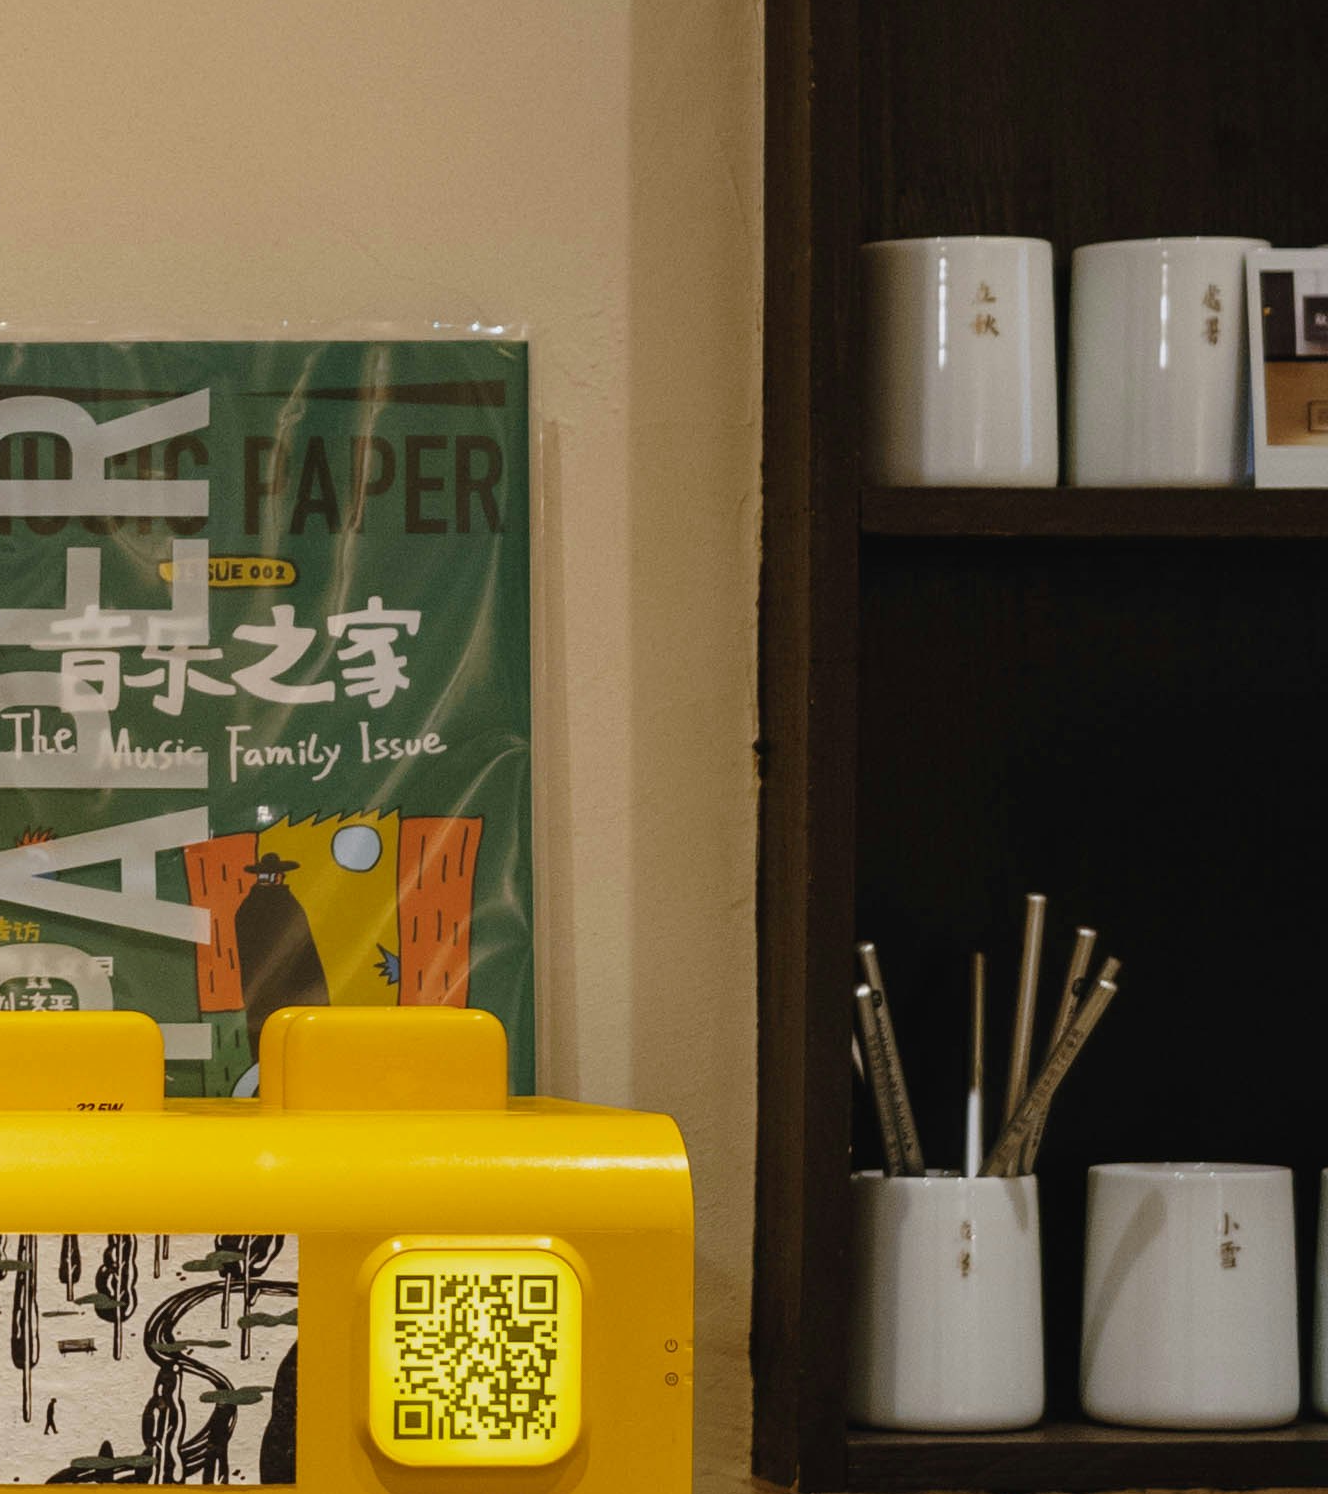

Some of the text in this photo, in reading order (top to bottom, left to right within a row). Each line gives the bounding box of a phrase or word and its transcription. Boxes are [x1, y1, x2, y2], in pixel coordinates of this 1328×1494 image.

[969, 280, 1000, 338] 立秋
[243, 434, 506, 535] PAPER
[249, 563, 287, 581] 002
[31, 595, 422, 716] 音乐之家
[0, 708, 448, 783] The Music Family Issue
